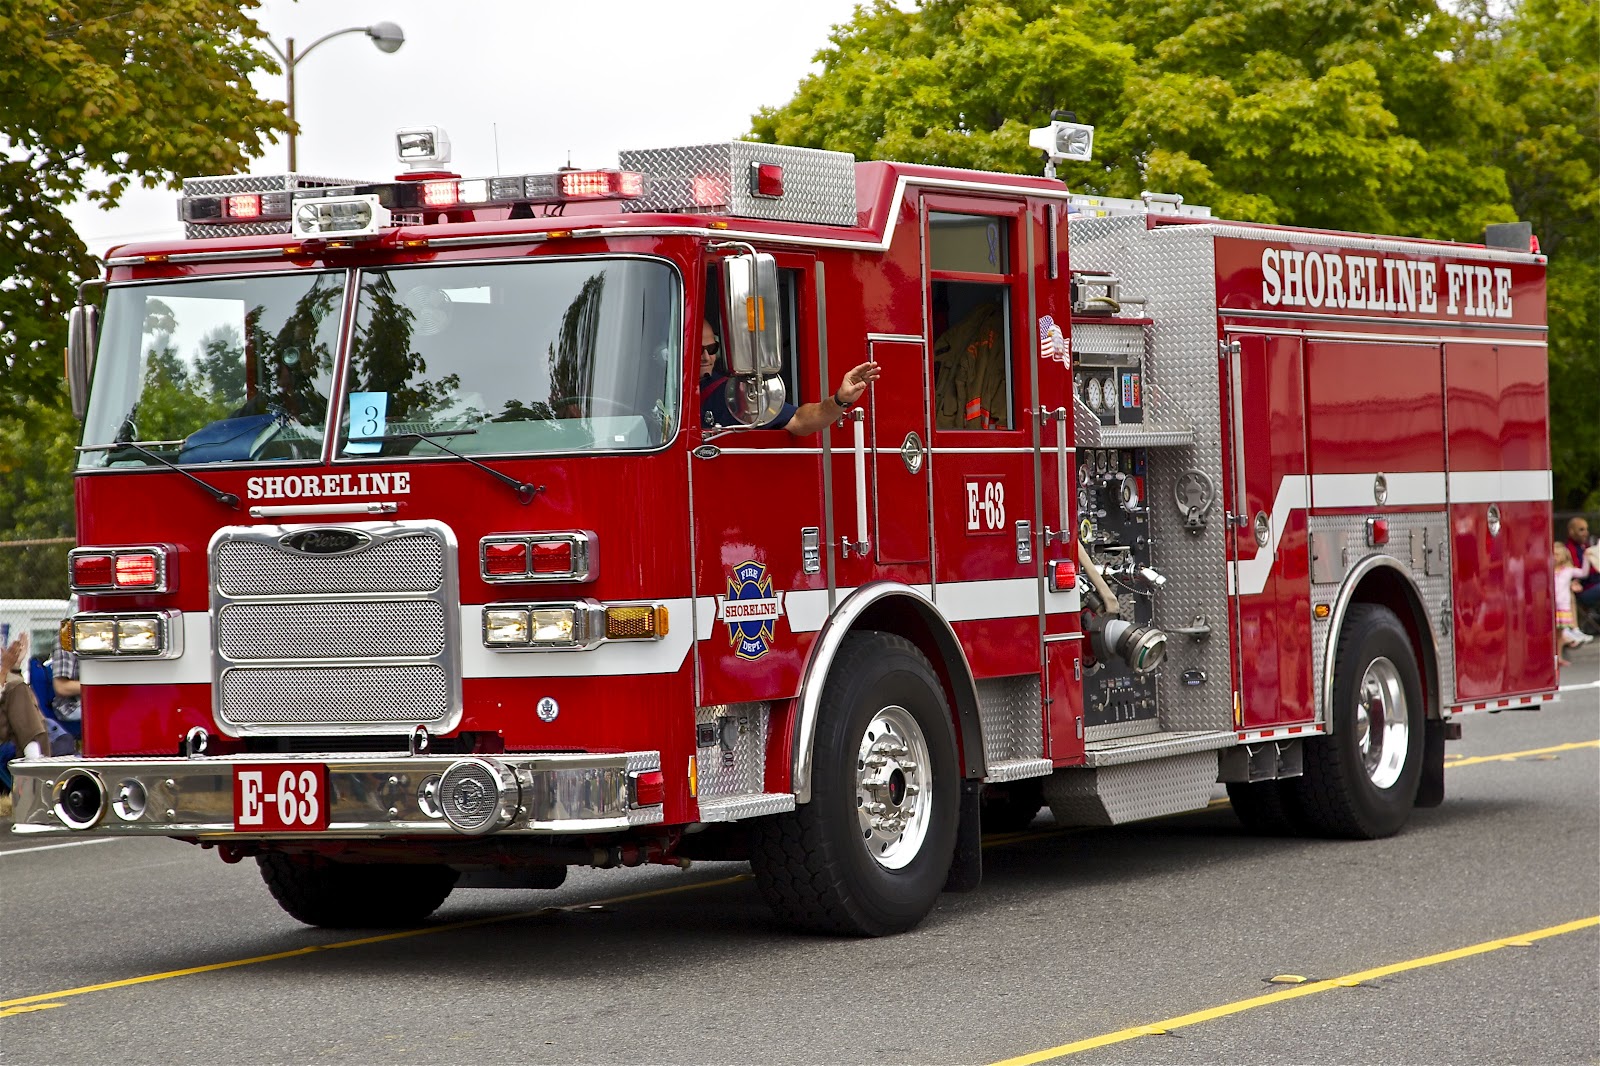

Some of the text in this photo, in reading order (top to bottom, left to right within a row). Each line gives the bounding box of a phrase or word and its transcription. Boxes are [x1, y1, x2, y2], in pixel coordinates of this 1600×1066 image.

[1261, 247, 1513, 319] SHORELINE FIRE
[361, 405, 379, 436] 3
[247, 472, 411, 499] SHORELINE
[966, 481, 1006, 530] E-63
[300, 531, 350, 551] Pierce
[740, 567, 759, 580] FIRE
[725, 602, 777, 618] SHORELINE
[742, 640, 763, 653] DEPT.
[237, 770, 319, 826] E-63
